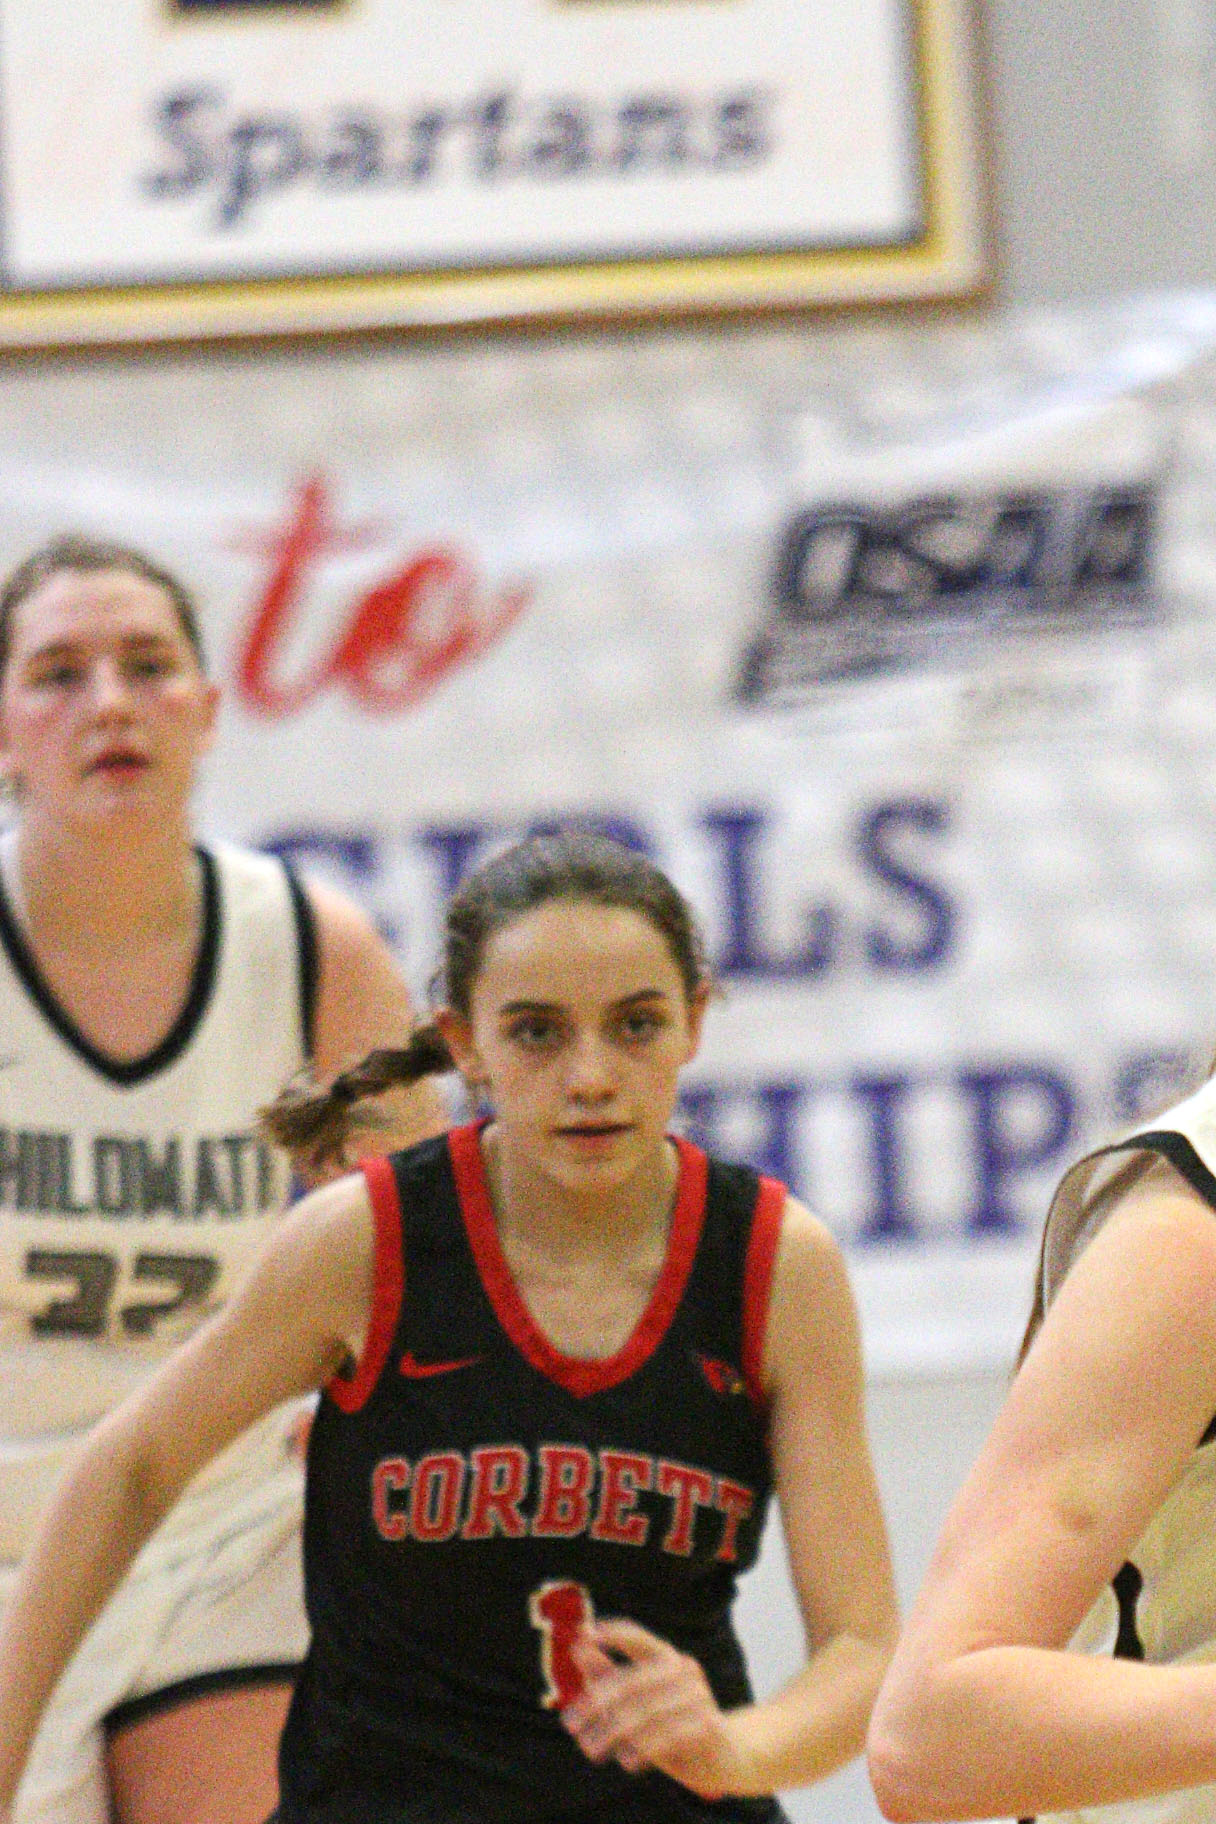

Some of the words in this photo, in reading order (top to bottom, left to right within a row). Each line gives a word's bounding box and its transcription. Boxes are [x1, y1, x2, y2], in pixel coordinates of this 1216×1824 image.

[144, 78, 778, 231] Spartans
[222, 474, 533, 718] to
[371, 1443, 757, 1564] CORBETT
